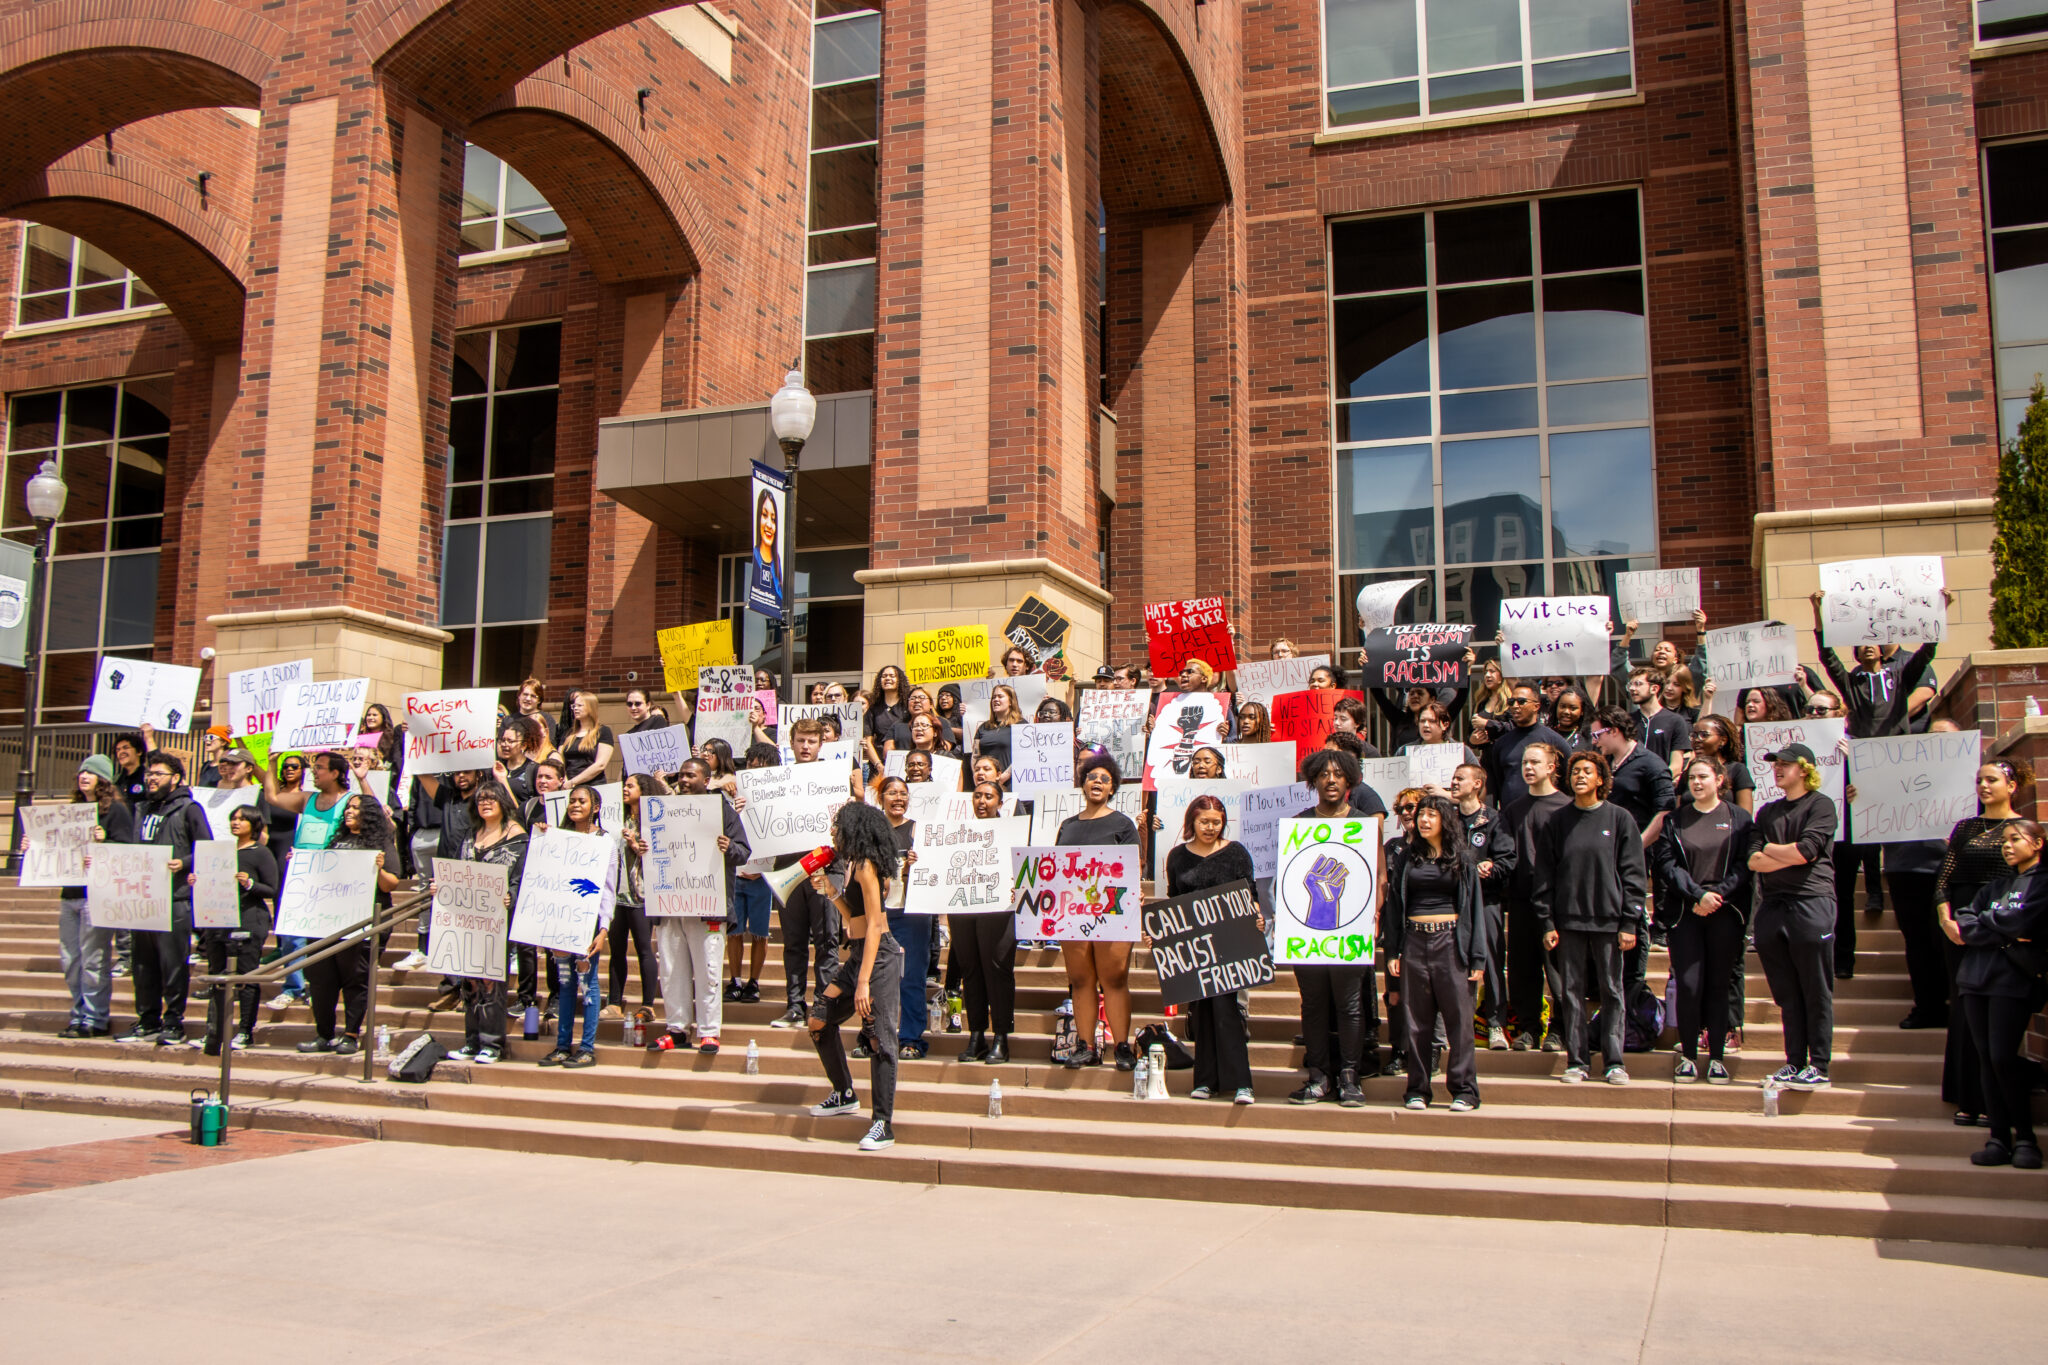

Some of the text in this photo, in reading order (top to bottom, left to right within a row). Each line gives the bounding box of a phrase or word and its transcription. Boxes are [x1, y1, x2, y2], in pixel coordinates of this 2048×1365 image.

[1654, 584, 1674, 597] NOT
[1145, 597, 1222, 621] HATE SPEECH
[1504, 601, 1598, 619] Witches
[1156, 609, 1224, 634] IS NEVER
[1382, 623, 1477, 636] TOLERATING
[1761, 627, 1785, 638] ONE
[938, 629, 955, 638] END
[1171, 624, 1220, 651] FREE
[1395, 632, 1463, 650] RACISM
[674, 648, 705, 665] WHITE
[939, 655, 955, 665] END
[1406, 646, 1431, 662] IS
[1512, 640, 1574, 661] Racisim
[240, 662, 302, 693] BE A BUDDY
[700, 667, 714, 680] OPEN
[720, 669, 732, 693] &
[732, 668, 746, 676] OPEN
[910, 661, 985, 682] TRANSMISOGYNY
[1383, 660, 1459, 684] RACISM
[139, 666, 158, 724] JUSTIC
[254, 687, 278, 713] NOT
[297, 681, 361, 706] BRING US
[698, 698, 721, 712] STOP
[722, 696, 735, 711] THE
[735, 696, 754, 710] HATE
[1084, 690, 1137, 705] HATE
[304, 707, 341, 728] LEGAL
[407, 696, 473, 716] Racism
[1081, 703, 1144, 722] SPEECH
[1279, 695, 1301, 719] WE
[629, 731, 675, 752] UNITED
[1019, 725, 1066, 749] Silence
[1279, 720, 1295, 740] TO
[1748, 726, 1805, 750] Brian
[409, 730, 495, 759] ANTI-Racism
[1853, 733, 1978, 772] EDUCATION
[1037, 750, 1048, 763] is
[1420, 756, 1440, 769] WE
[741, 767, 791, 789] Protect
[752, 782, 848, 803] Black + Brown
[1245, 793, 1254, 812] If
[1256, 792, 1286, 810] You're
[22, 806, 55, 828] Your
[746, 805, 828, 839] Voices
[1855, 793, 1977, 838] IGNORANCE
[924, 823, 994, 848] Hating
[1242, 820, 1272, 840] Hearing
[1283, 822, 1332, 855] NO
[1343, 821, 1364, 844] 2
[564, 834, 600, 867] Pack
[950, 848, 999, 868] ONE
[291, 850, 338, 876] END
[1015, 851, 1124, 889] NO Justice
[114, 875, 152, 899] THE
[438, 861, 505, 897] Hating
[913, 868, 1000, 890] Is Hating
[284, 878, 367, 914] Systemic
[948, 885, 999, 907] ALL
[1016, 889, 1056, 916] NO
[1060, 890, 1104, 916] Peace
[520, 893, 595, 924] Against
[1144, 888, 1257, 941] CALL OUT YOUR
[1079, 915, 1107, 938] BLM
[430, 930, 505, 978] ALL
[1152, 933, 1218, 980] RACIST
[1286, 933, 1374, 962] RACISM
[1197, 954, 1274, 998] FRIENDS
